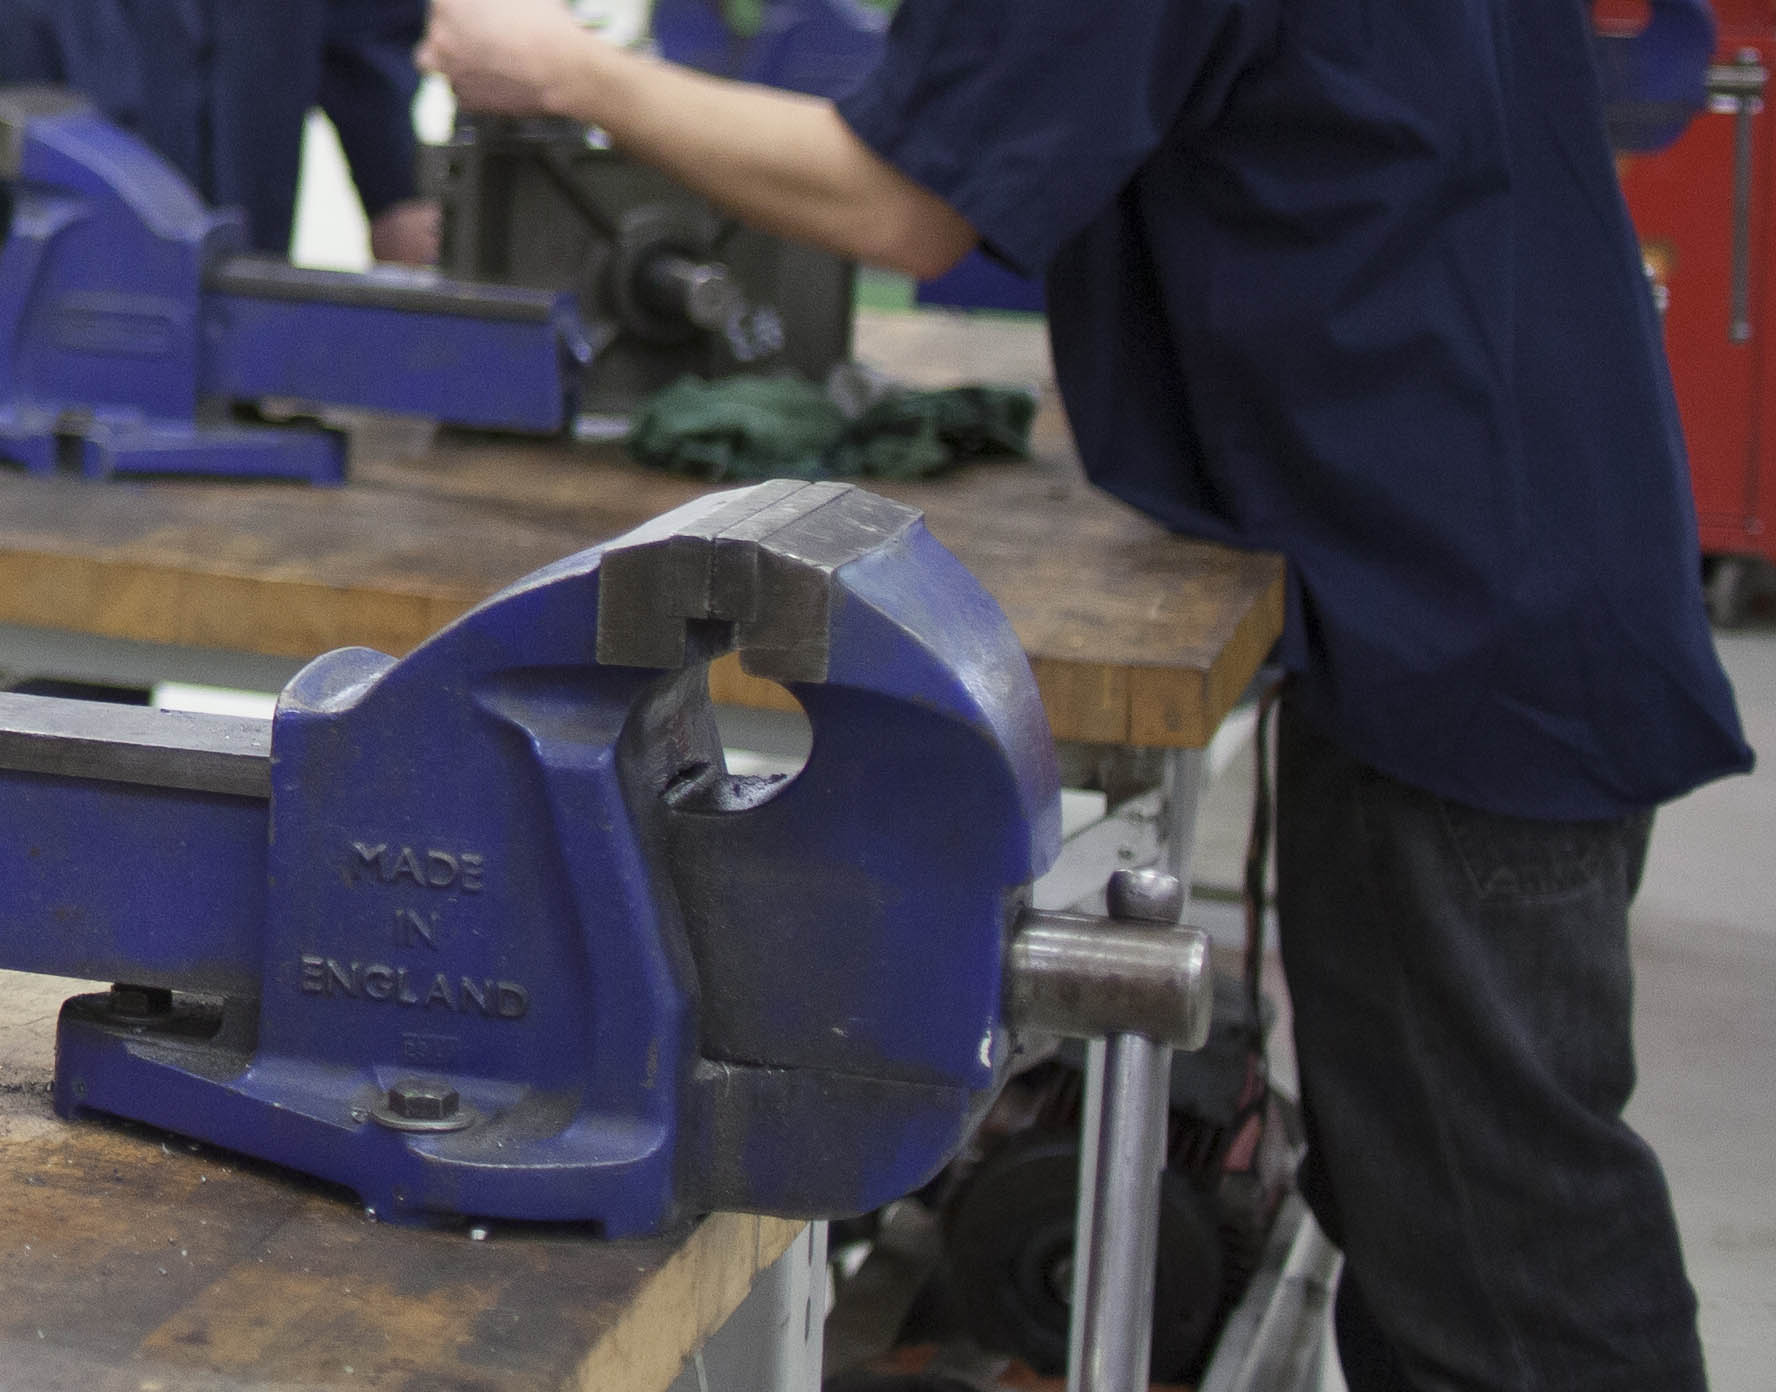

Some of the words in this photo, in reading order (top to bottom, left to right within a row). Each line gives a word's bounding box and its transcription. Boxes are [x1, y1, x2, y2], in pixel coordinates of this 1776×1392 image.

[344, 840, 485, 894] MADE
[394, 907, 440, 950] IN
[300, 955, 532, 1020] ENGLAND
